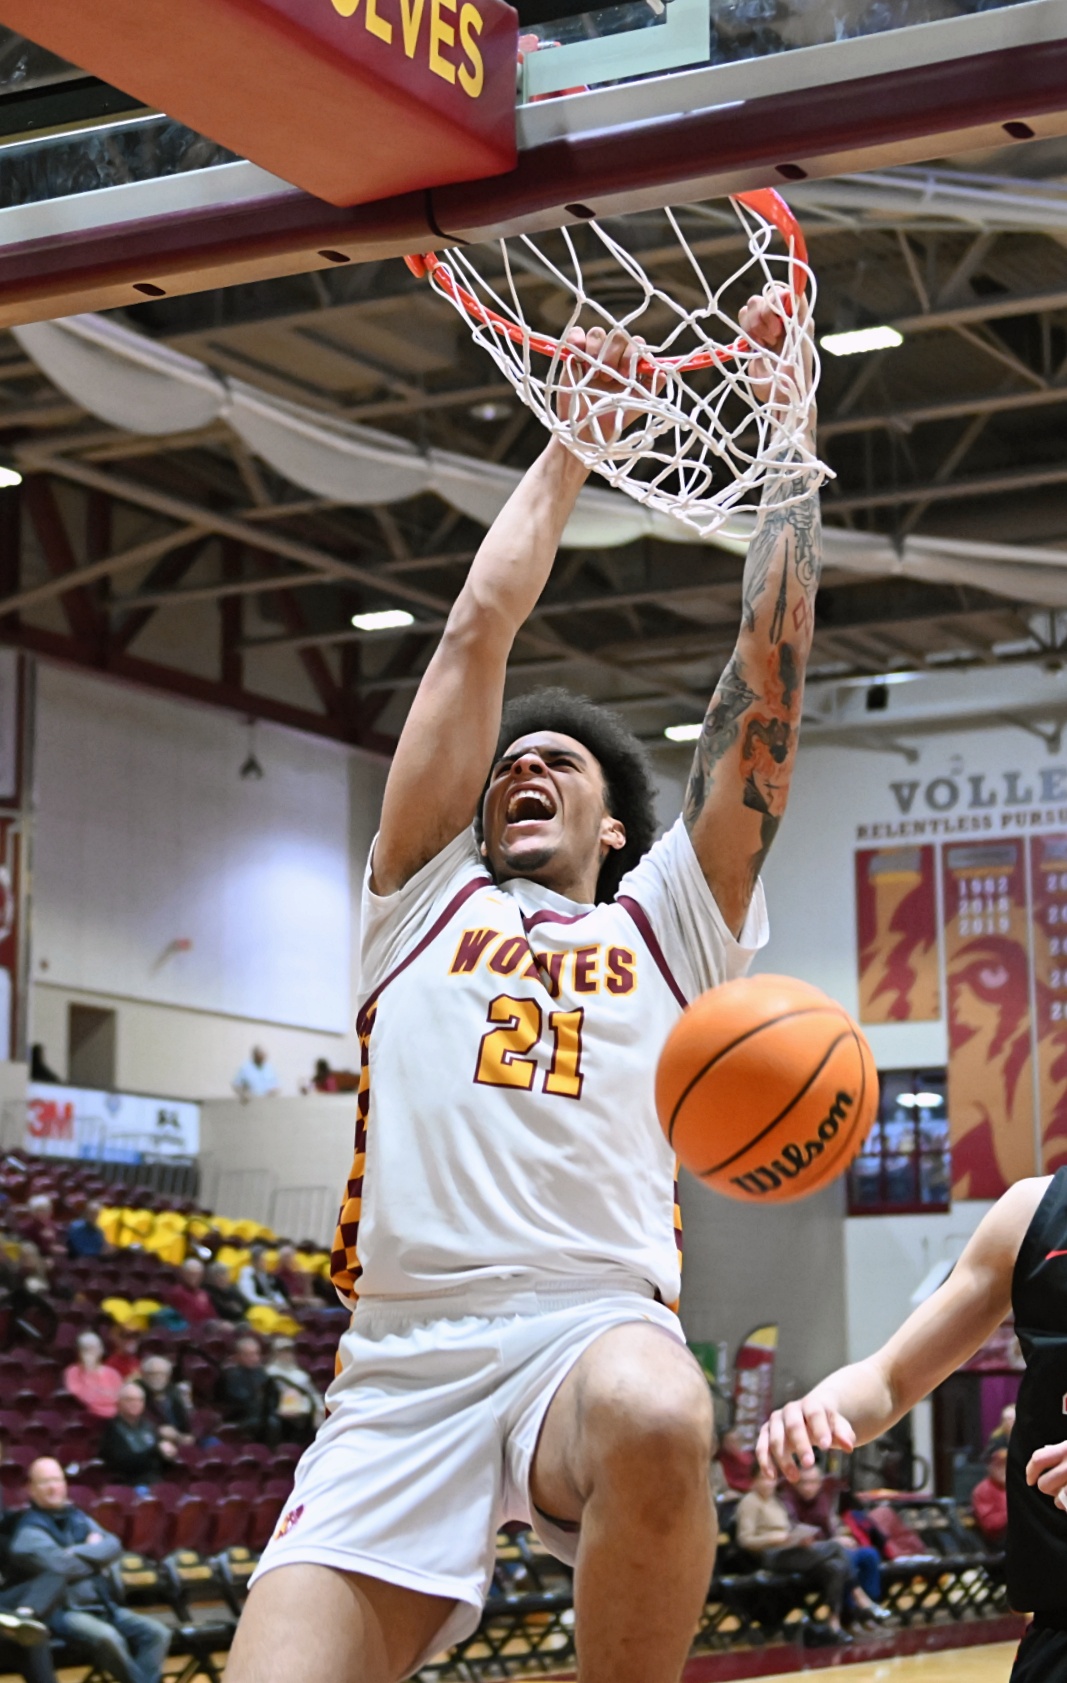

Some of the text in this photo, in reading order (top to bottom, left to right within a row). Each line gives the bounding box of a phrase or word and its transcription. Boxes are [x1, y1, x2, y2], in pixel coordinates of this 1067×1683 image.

[330, 0, 484, 98] LVES
[856, 814, 993, 840] RELENTLESS
[889, 767, 1067, 815] VOLLE
[473, 993, 584, 1100] 21
[27, 1098, 74, 1141] 3M
[730, 1089, 853, 1195] Wilson
